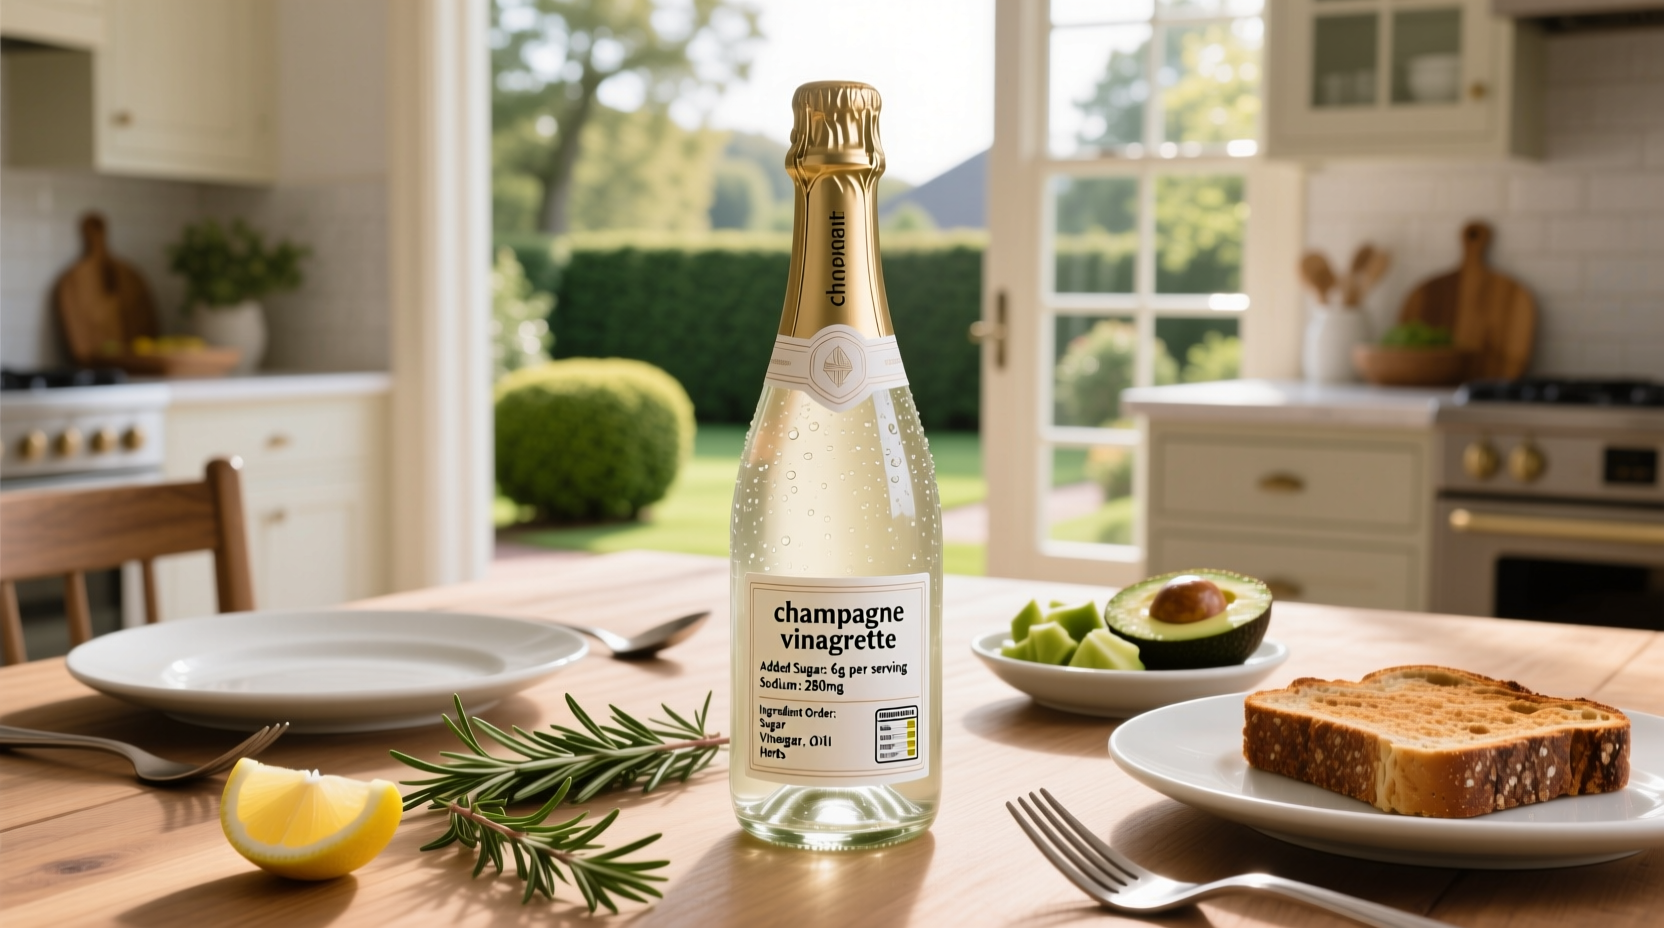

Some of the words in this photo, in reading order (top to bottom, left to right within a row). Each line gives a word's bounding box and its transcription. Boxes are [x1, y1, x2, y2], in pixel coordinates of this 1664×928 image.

[774, 601, 904, 629] champagne
[781, 628, 896, 656] vinagrette
[760, 660, 791, 673] Added
[831, 662, 845, 678] 6g
[849, 664, 868, 678] per
[871, 661, 908, 675] serving
[805, 707, 836, 718] Order:
[759, 718, 786, 732] Sugar
